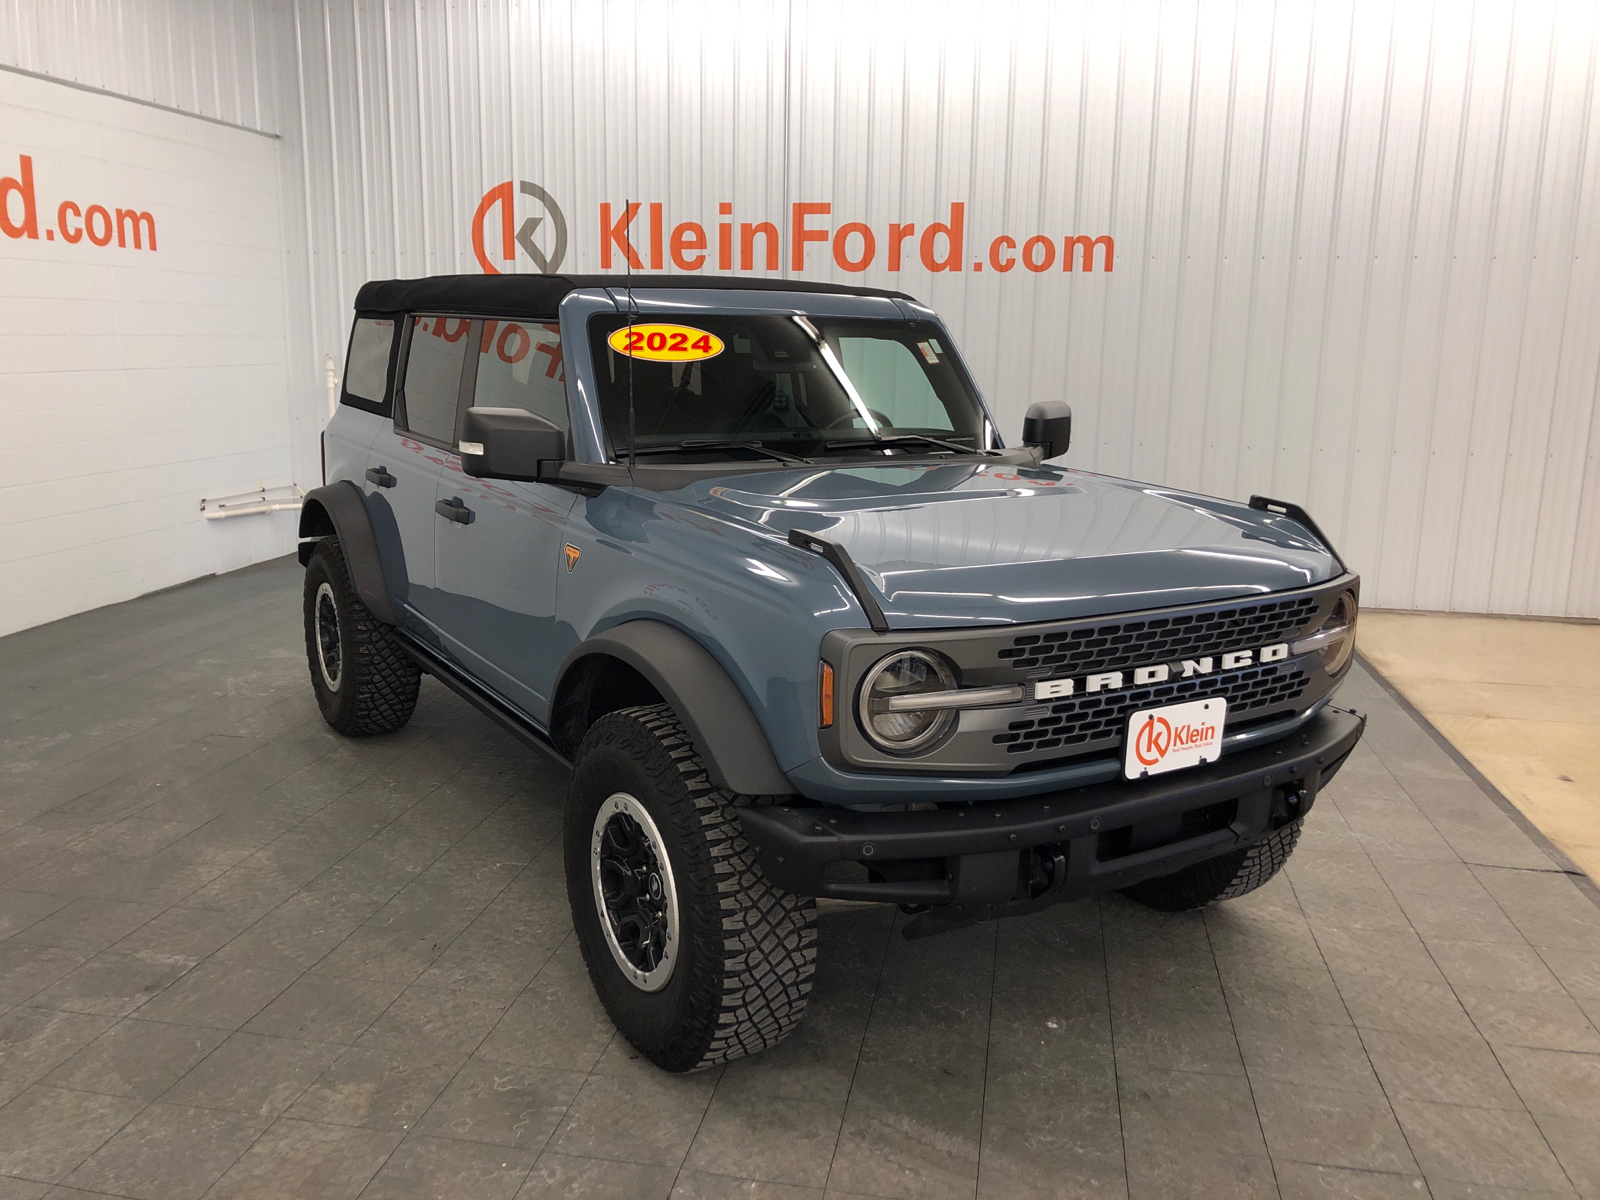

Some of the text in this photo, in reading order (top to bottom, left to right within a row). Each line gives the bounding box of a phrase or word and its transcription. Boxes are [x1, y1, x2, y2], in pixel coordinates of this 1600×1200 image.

[599, 201, 1115, 274] KleinFord.com
[622, 331, 713, 354] 2024
[1034, 643, 1289, 700] BRONCO
[1173, 721, 1216, 747] Klein
